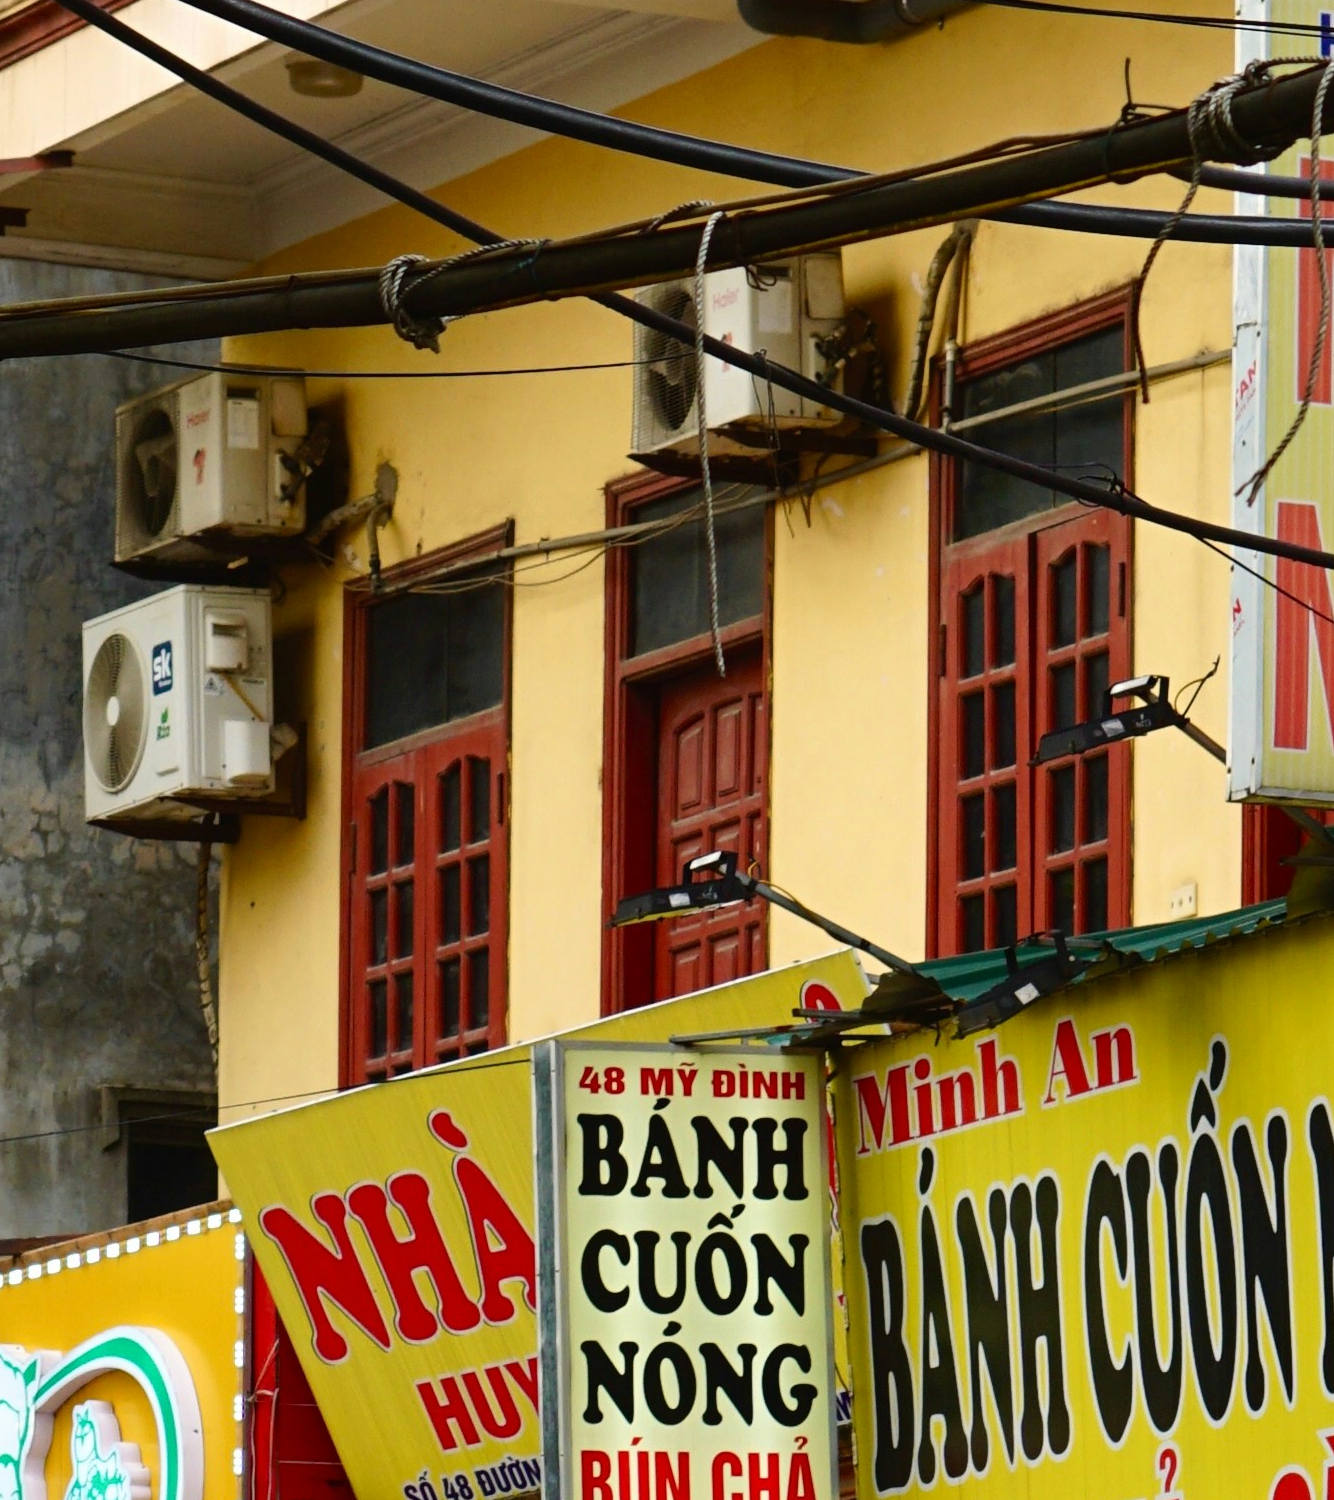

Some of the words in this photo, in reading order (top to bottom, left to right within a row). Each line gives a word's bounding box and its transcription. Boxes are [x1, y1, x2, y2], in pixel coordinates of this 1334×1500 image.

[578, 1067, 625, 1095] 48
[640, 1063, 699, 1100] MỸ
[711, 1063, 805, 1100] ĐÌNH
[1049, 1018, 1140, 1101] An
[578, 1098, 810, 1201] BÁNH
[581, 1203, 810, 1317] CUỐN
[861, 1147, 1072, 1493] BÁNH
[1084, 1036, 1297, 1446] CUỐN
[581, 1321, 817, 1428] NÓNG
